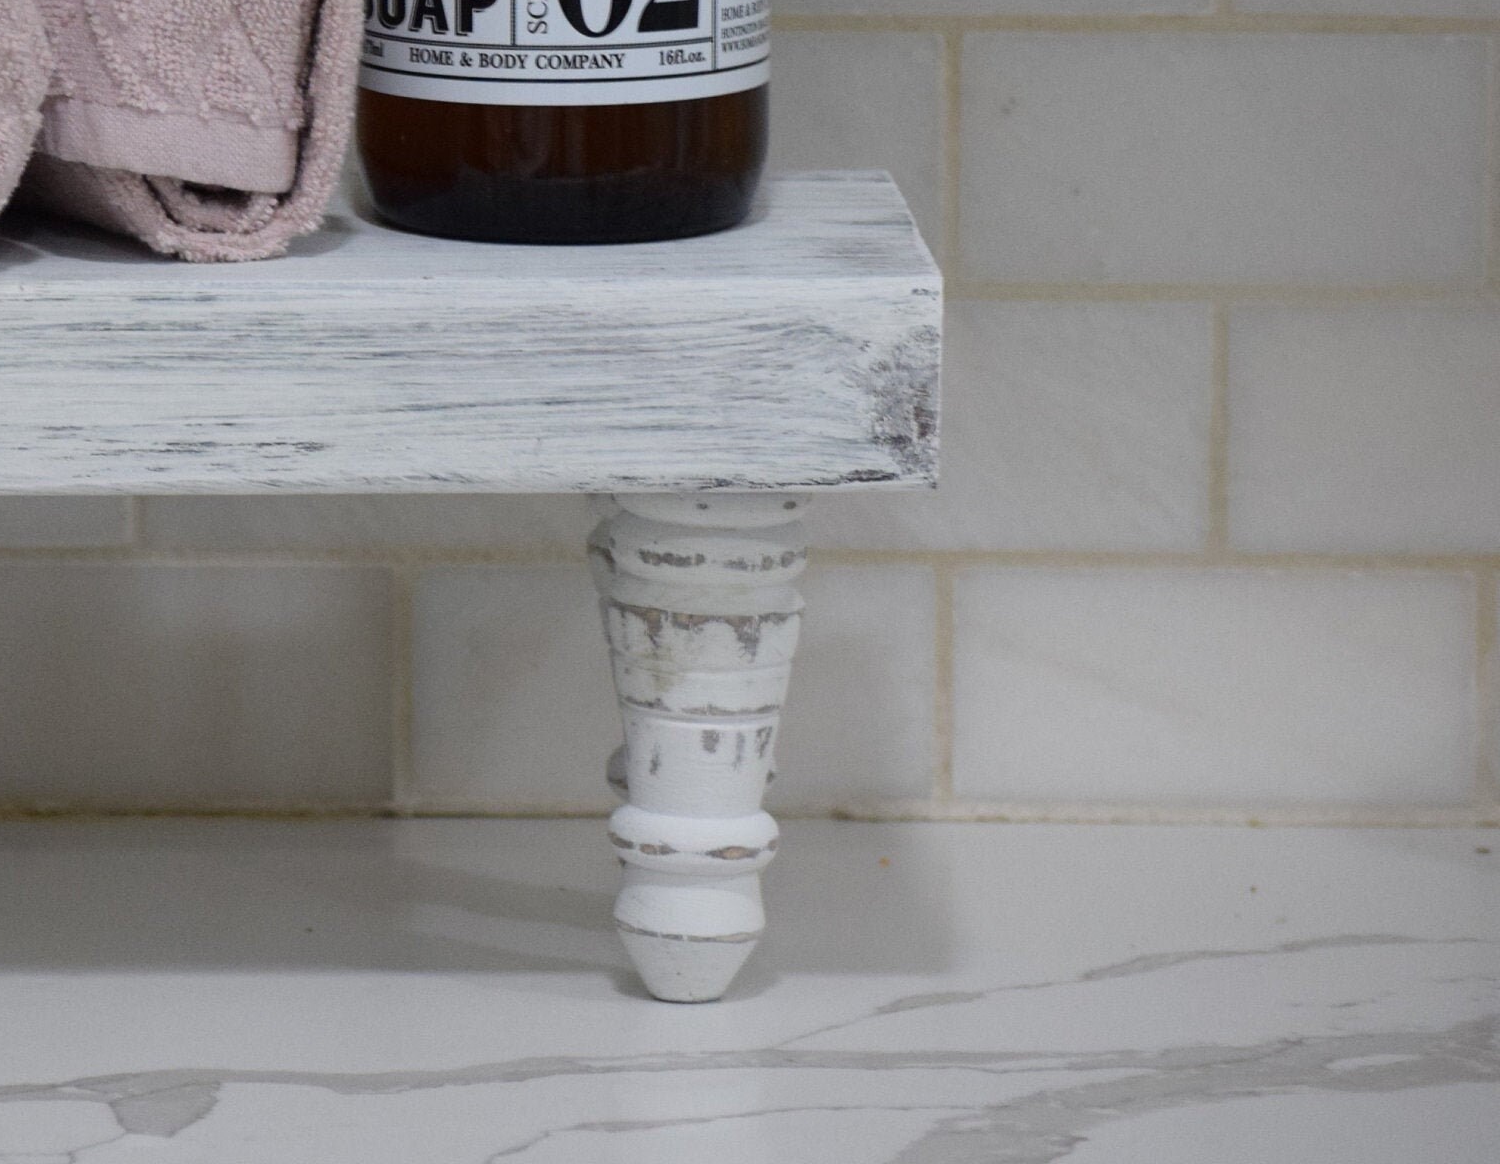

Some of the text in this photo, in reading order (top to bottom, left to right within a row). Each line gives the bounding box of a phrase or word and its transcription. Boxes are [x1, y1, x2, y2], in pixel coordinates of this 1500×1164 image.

[409, 47, 625, 70] HOME & BODY COMPANY
